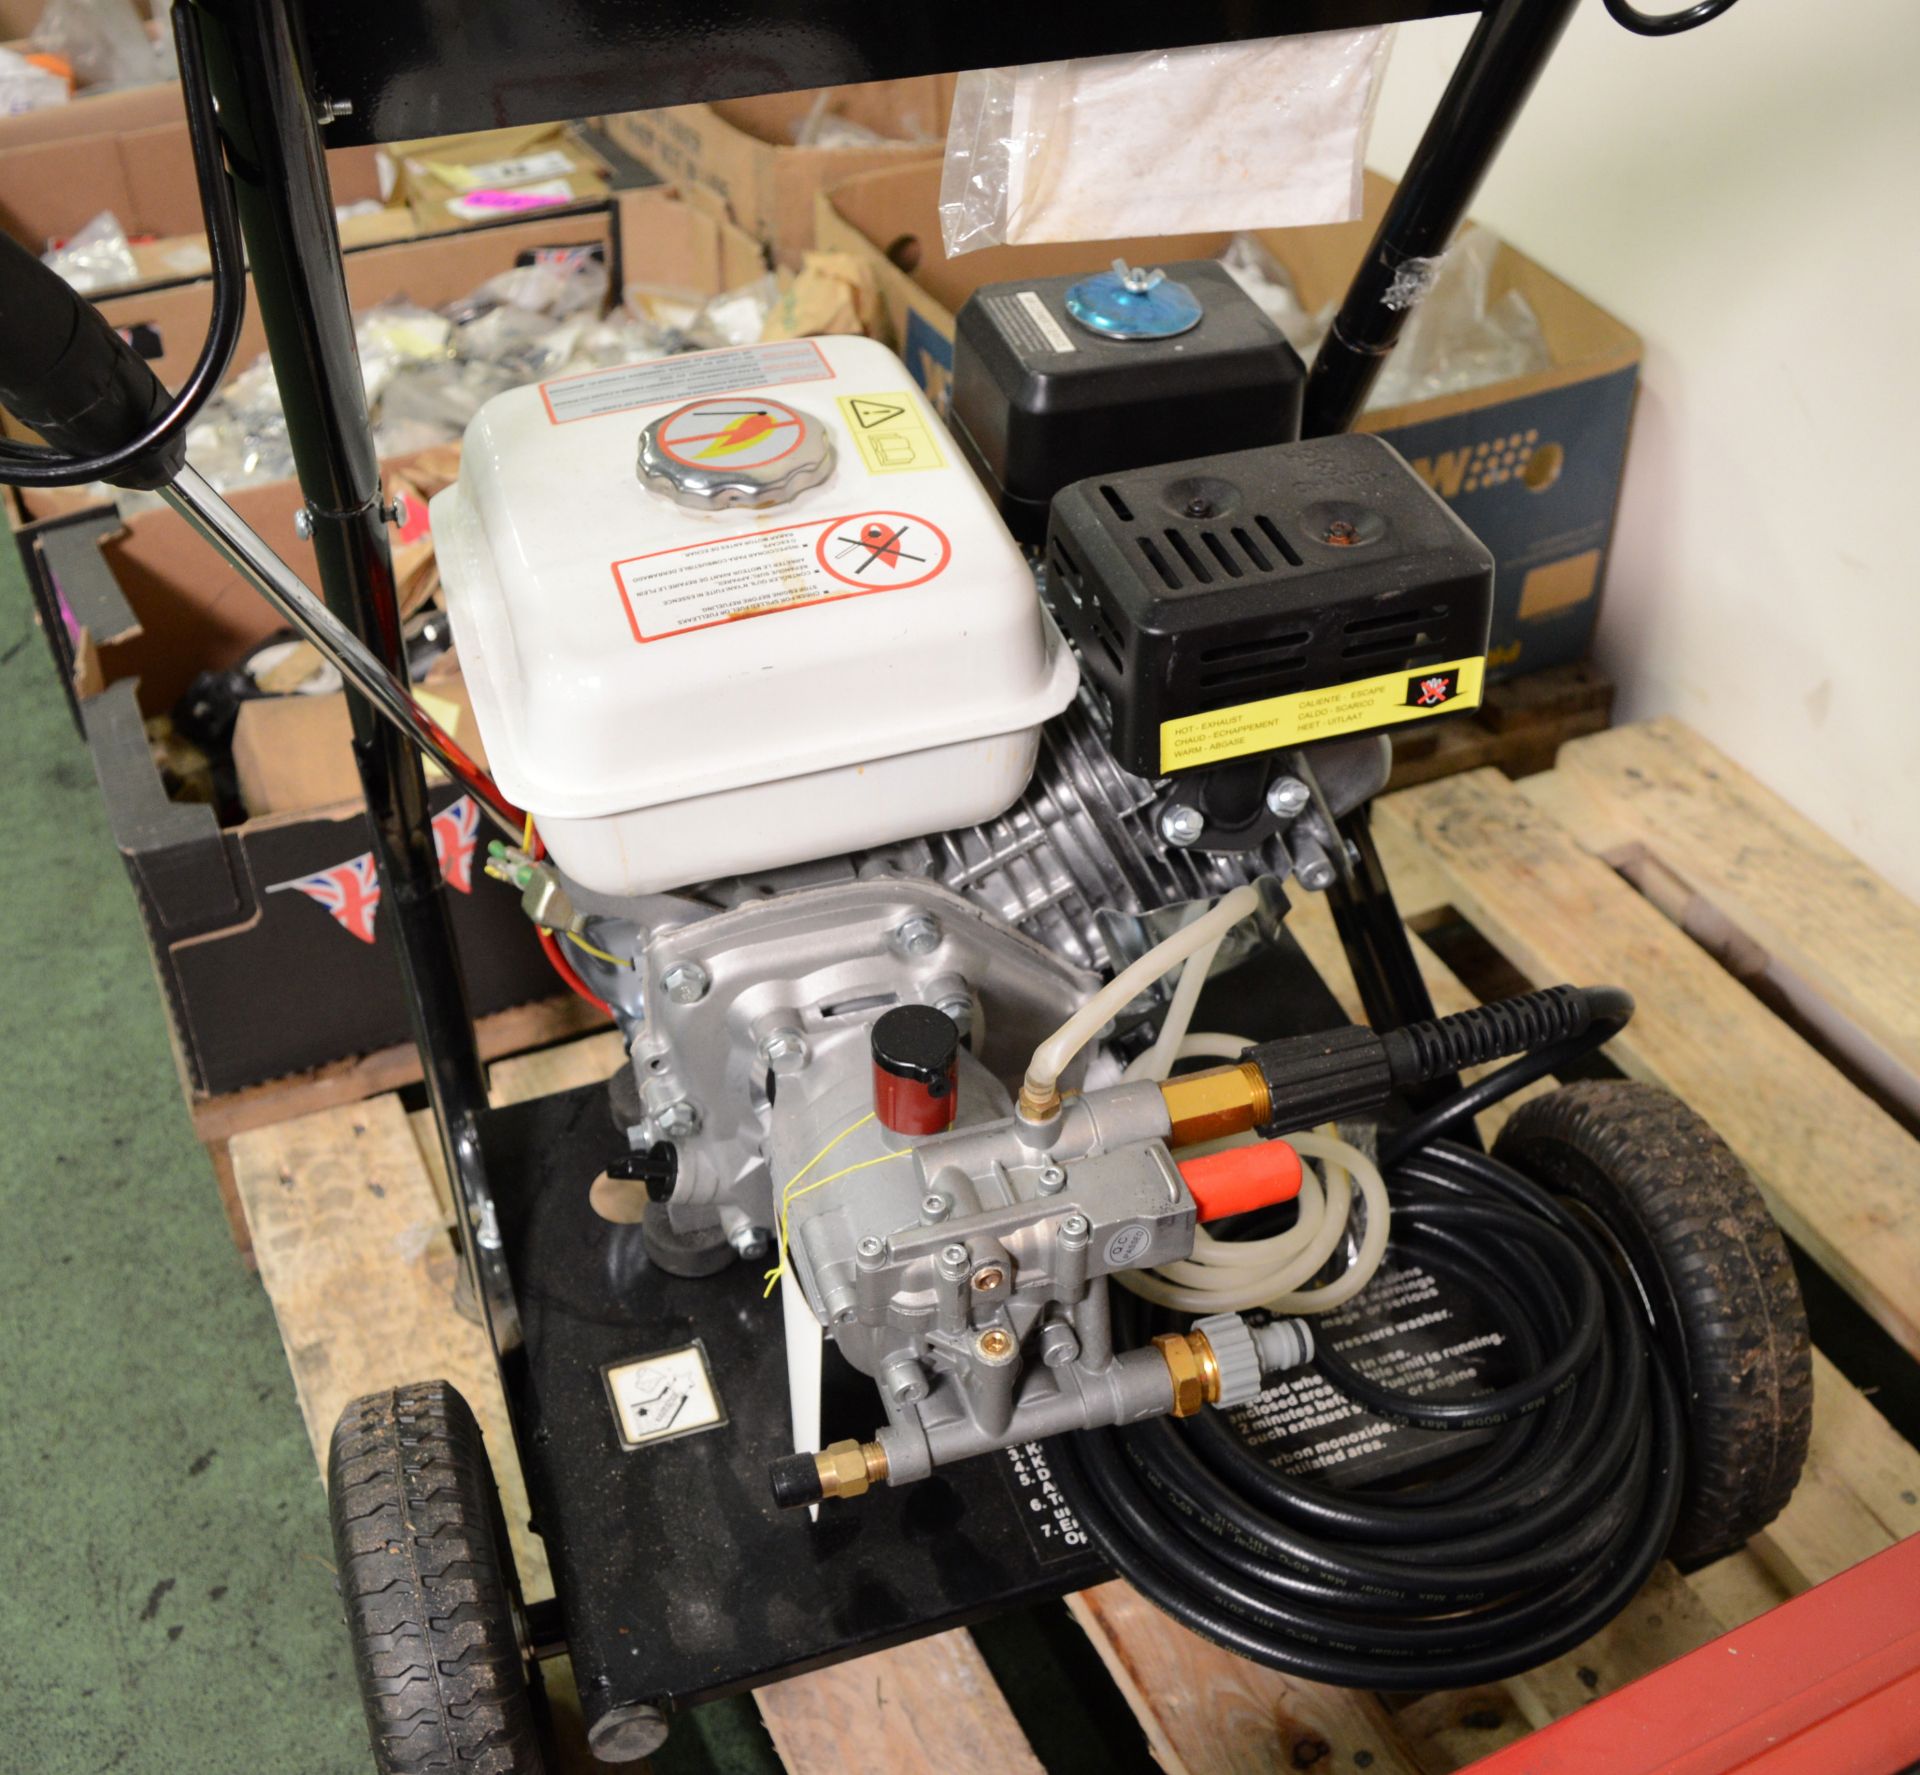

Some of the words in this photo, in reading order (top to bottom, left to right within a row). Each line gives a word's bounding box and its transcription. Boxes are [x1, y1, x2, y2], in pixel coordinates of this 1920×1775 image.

[1298, 694, 1341, 710] CALIENTE
[1174, 734, 1206, 747] CHAUD
[1213, 718, 1280, 738] ECHAPPEMENT
[1175, 726, 1194, 736] HOT
[1201, 715, 1243, 730] EXHAUST
[1174, 746, 1202, 758] WARM
[1395, 1309, 1453, 1333] washer.
[1378, 1349, 1411, 1366] use.
[1395, 1354, 1427, 1373] unit
[1425, 1350, 1442, 1365] is
[1442, 1332, 1506, 1359] running.
[1290, 1374, 1324, 1392] whe
[1426, 1367, 1478, 1391] engine
[1238, 1422, 1250, 1435] 2
[1252, 1405, 1315, 1431] minutes
[1247, 1426, 1288, 1447] ouch
[1288, 1406, 1351, 1434] exhaust
[1007, 1448, 1026, 1462] 3.
[1285, 1449, 1346, 1476] ntilated
[1346, 1440, 1387, 1459] area.
[1014, 1460, 1031, 1473] 4.
[1019, 1473, 1037, 1487] 5.
[1030, 1498, 1048, 1512] 6.
[1040, 1523, 1060, 1538] 7.
